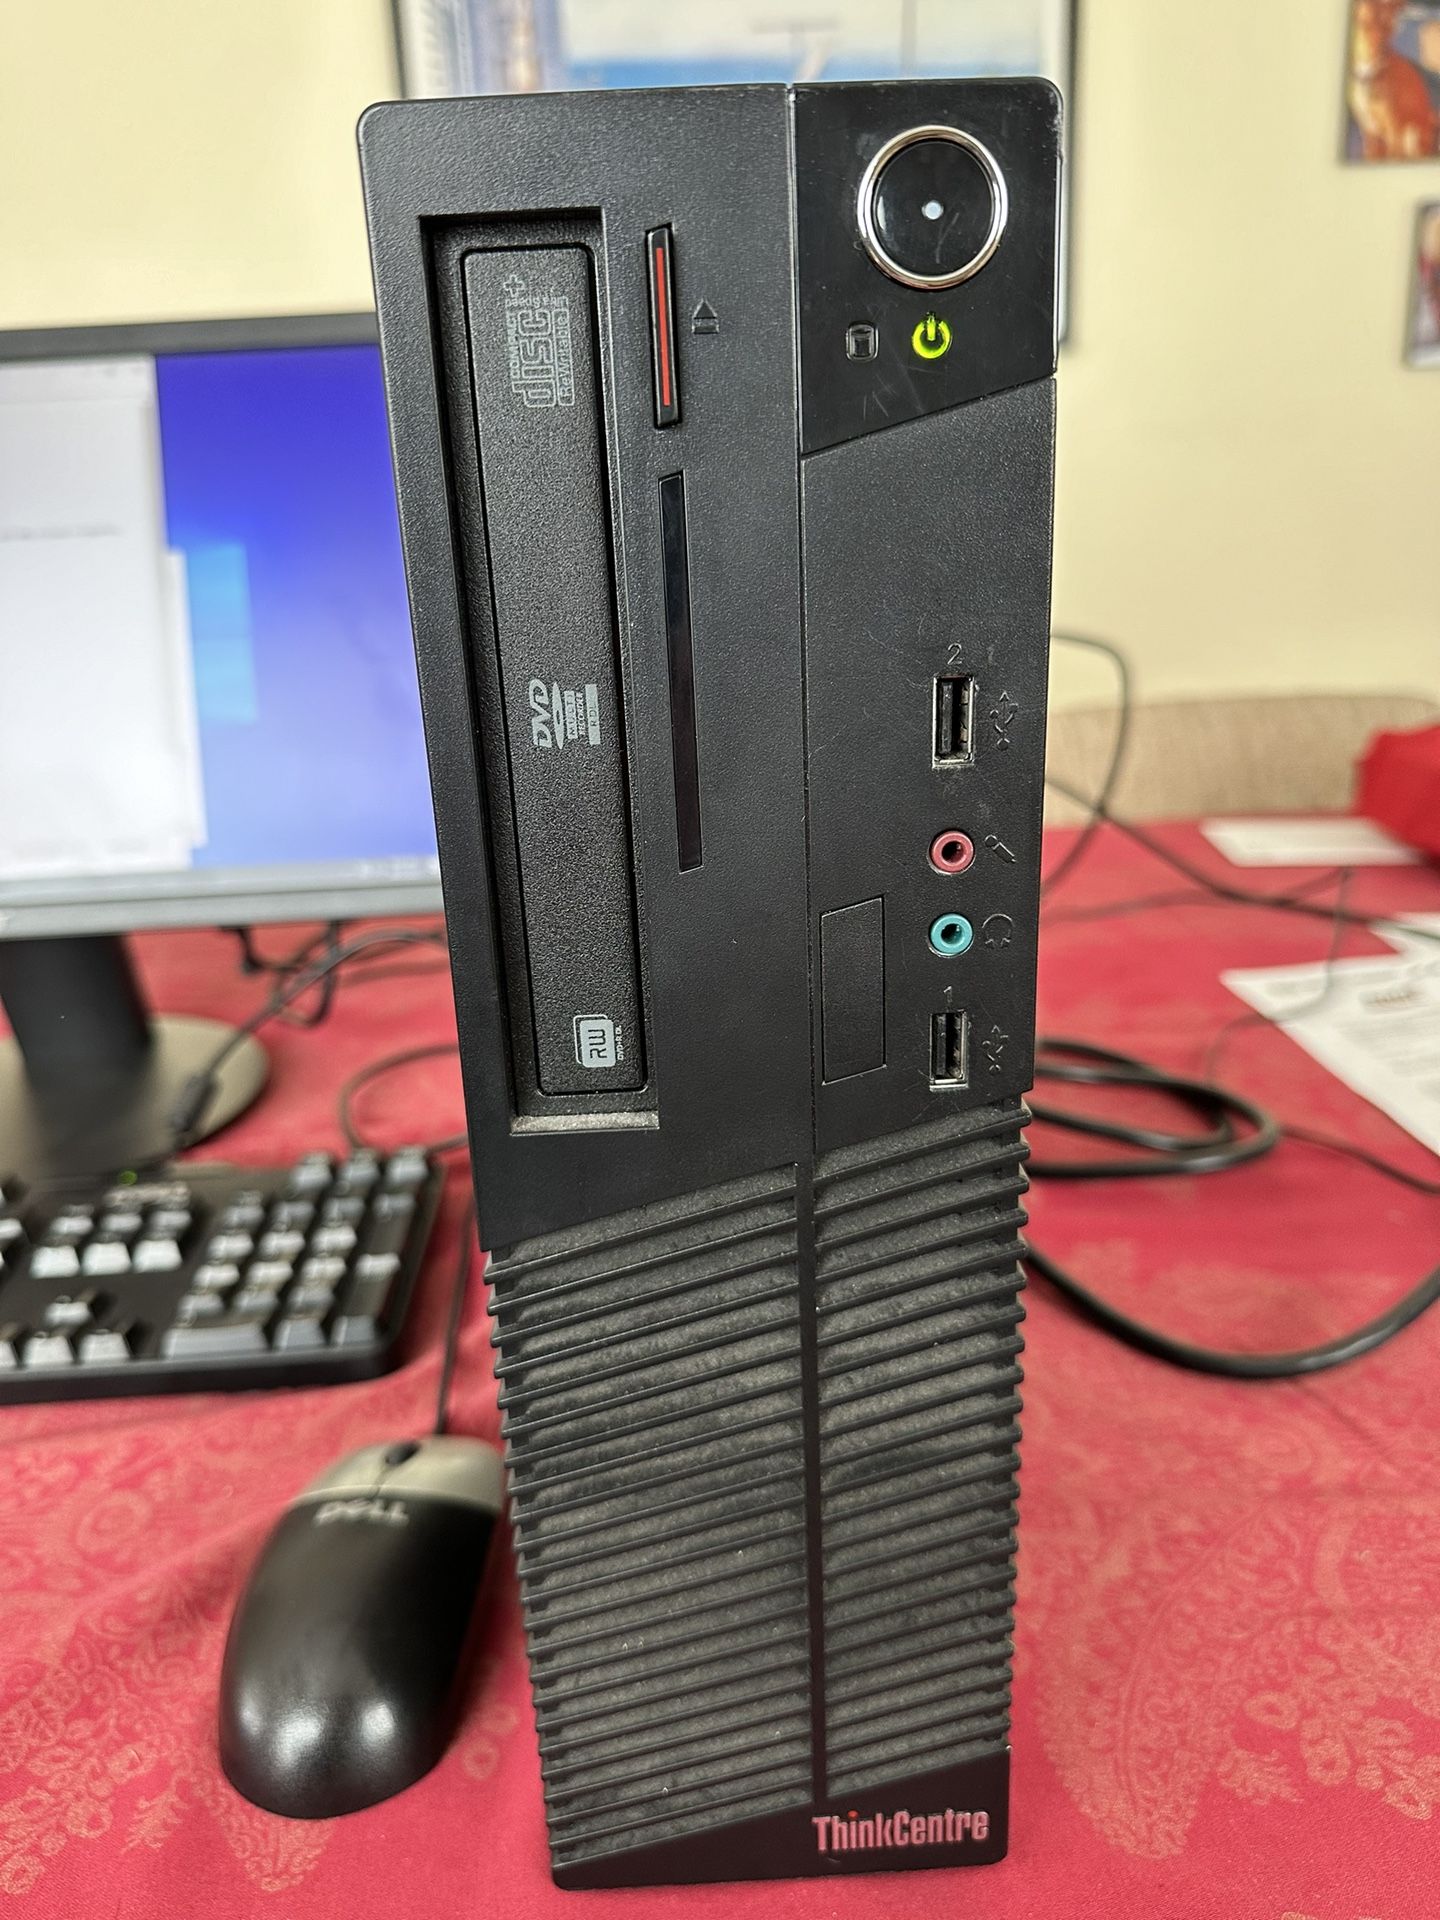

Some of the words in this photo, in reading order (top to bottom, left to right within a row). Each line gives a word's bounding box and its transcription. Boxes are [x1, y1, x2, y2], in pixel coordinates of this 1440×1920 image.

[506, 311, 520, 379] COMPACT
[512, 310, 556, 407] disc
[557, 317, 571, 397] ReWritable
[947, 643, 962, 665] 2
[528, 679, 552, 747] DVD
[566, 694, 576, 736] MULTI
[943, 985, 953, 1004] 1
[588, 1029, 607, 1059] RW
[811, 1808, 990, 1851] ThinkCentre
